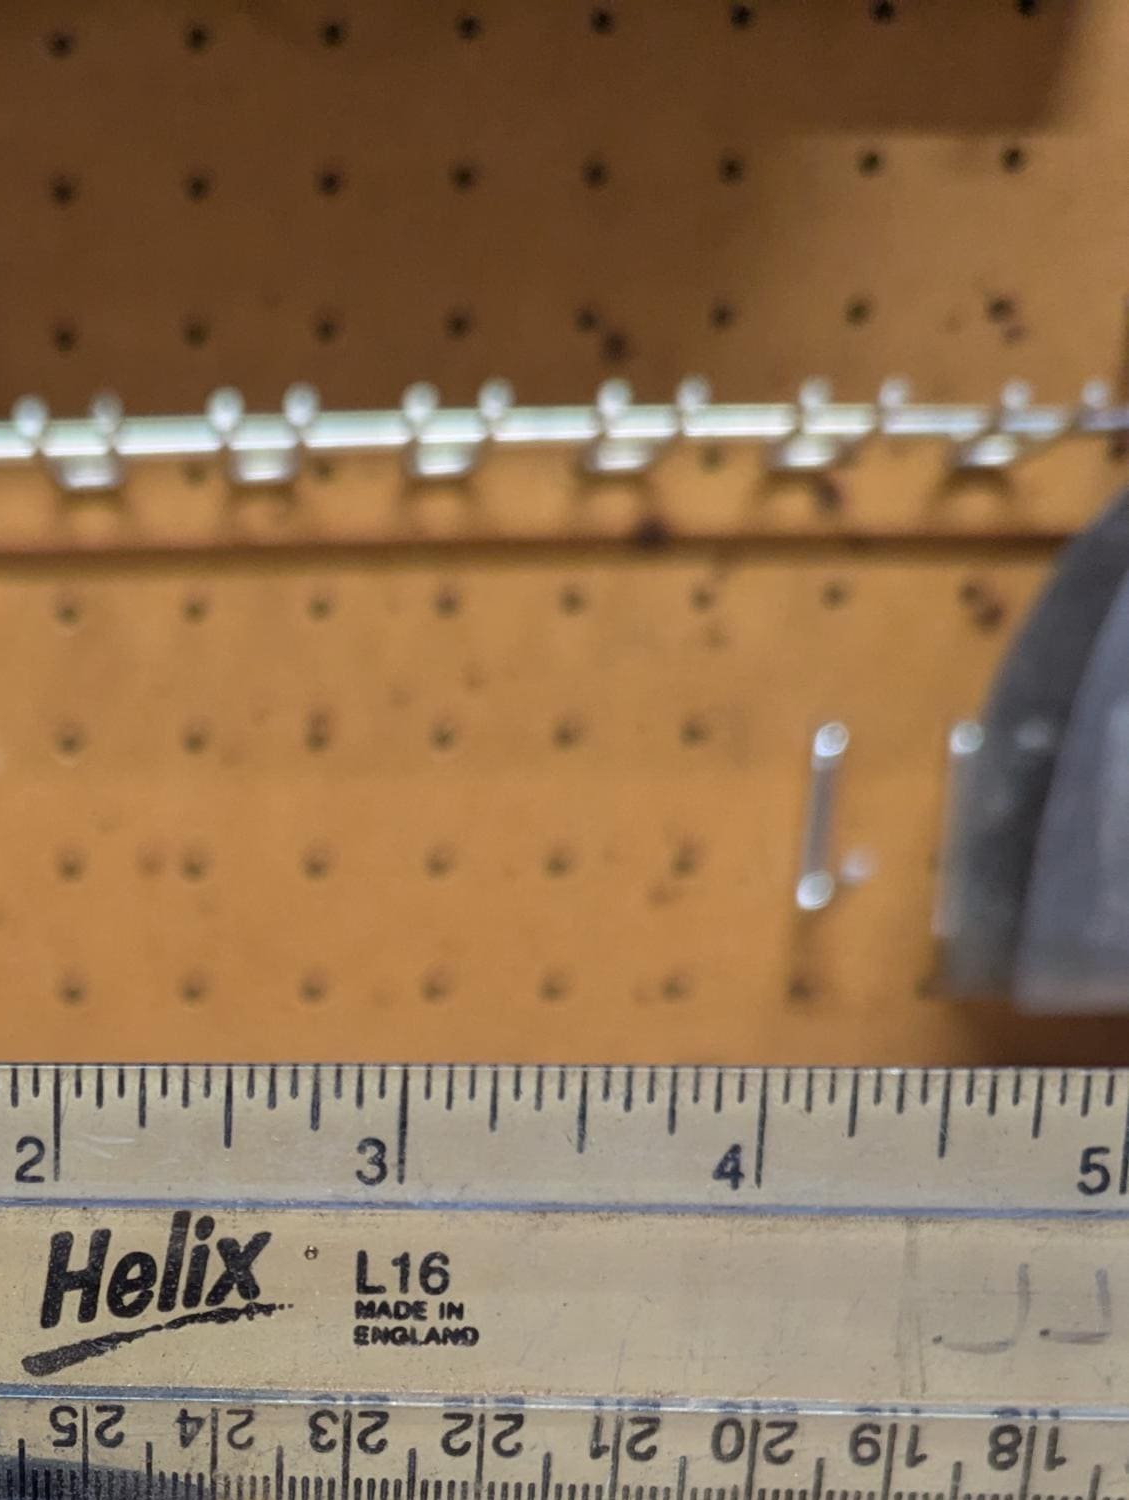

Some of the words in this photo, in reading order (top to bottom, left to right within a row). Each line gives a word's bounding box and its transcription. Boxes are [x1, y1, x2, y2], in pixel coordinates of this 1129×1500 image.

[15, 1136, 45, 1183] 2
[356, 1137, 388, 1185] 3
[712, 1143, 745, 1190] 4
[1077, 1147, 1111, 1195] 5
[39, 1211, 272, 1329] Helix
[356, 1250, 451, 1296] L16
[354, 1301, 428, 1321] MADE
[438, 1301, 464, 1321] IN
[353, 1326, 480, 1347] ENGLAND
[49, 1405, 126, 1449] 25
[176, 1408, 256, 1450] 24
[308, 1409, 389, 1454] 23
[441, 1412, 525, 1458] 22
[589, 1416, 661, 1462] 21
[710, 1418, 799, 1465] 20
[848, 1423, 928, 1468] 19
[987, 1424, 1067, 1472] 18
